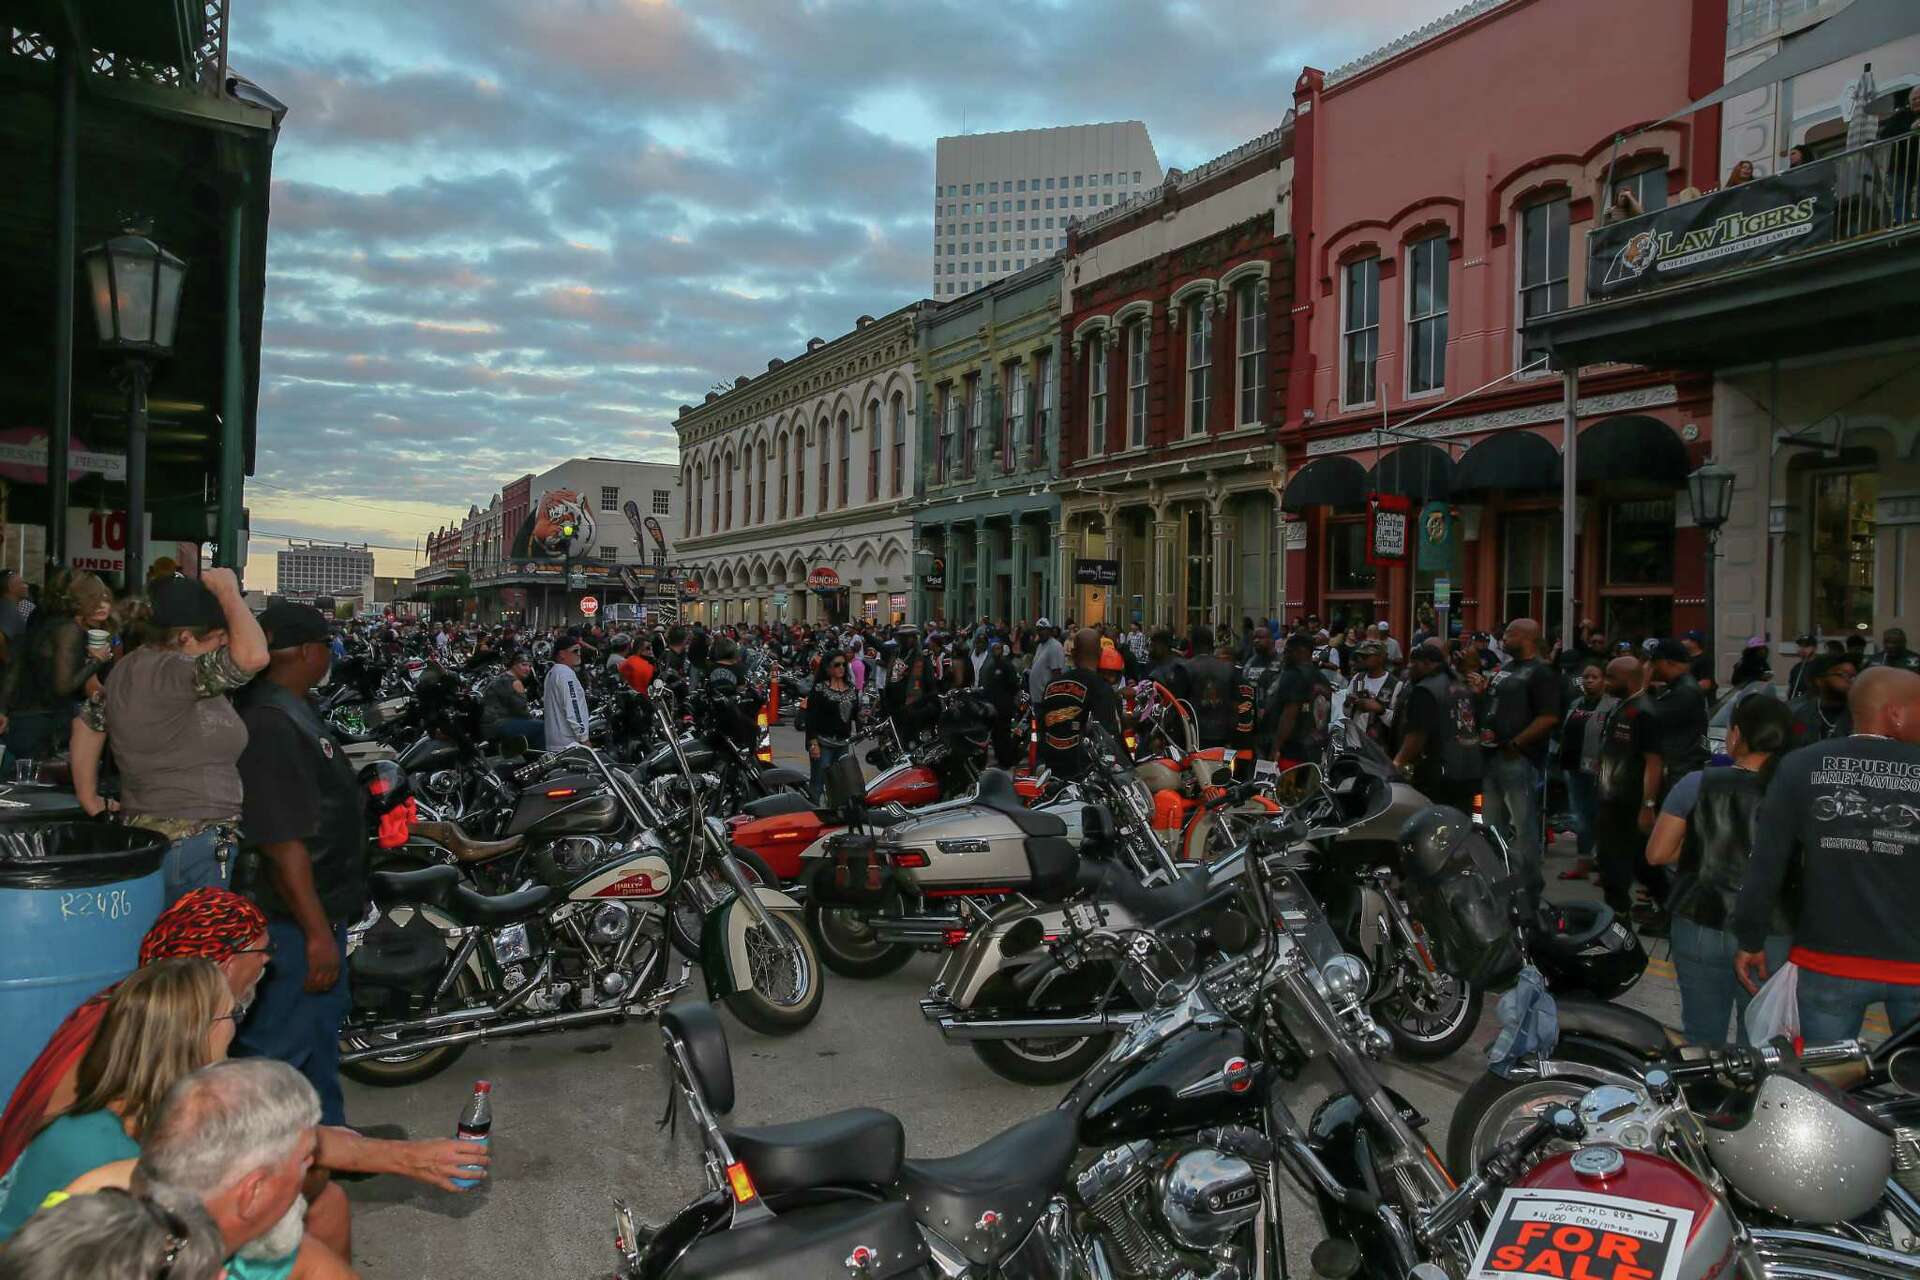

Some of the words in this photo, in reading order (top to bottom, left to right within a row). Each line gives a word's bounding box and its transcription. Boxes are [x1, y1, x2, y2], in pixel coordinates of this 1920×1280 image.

[1662, 253, 1704, 270] AMERICA'S
[1706, 238, 1763, 260] MOTORCYCLE
[1765, 225, 1809, 244] LAWYERS
[73, 558, 125, 571] UNDE
[659, 583, 677, 593] FREE
[809, 575, 839, 585] BUNCHA
[582, 601, 596, 609] STOP
[1823, 757, 1920, 778] REPUBLIC
[1811, 771, 1920, 793] HARLEY-DAVIDSO
[60, 889, 132, 921] R2486
[1516, 1222, 1642, 1266] FOR
[1491, 1245, 1654, 1280] SALE
